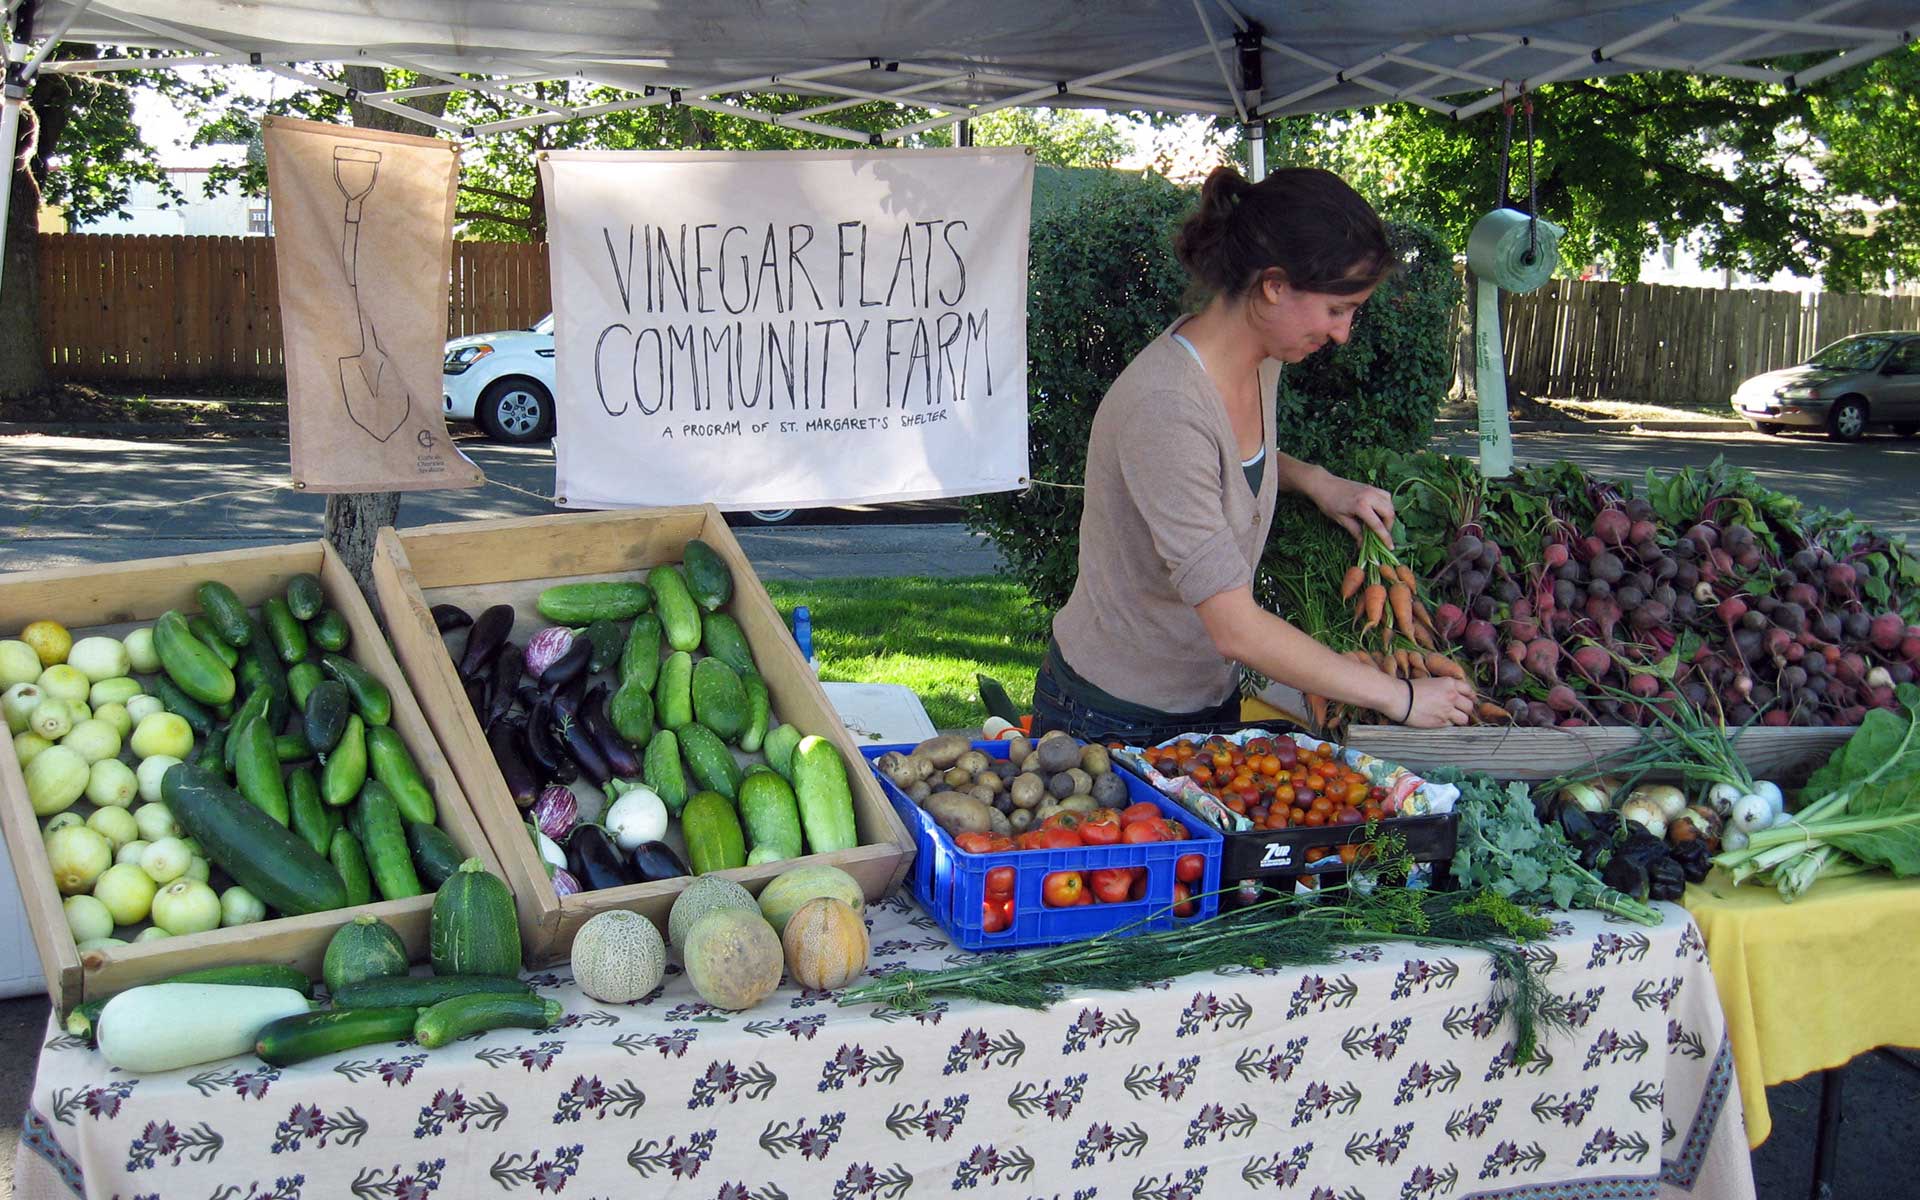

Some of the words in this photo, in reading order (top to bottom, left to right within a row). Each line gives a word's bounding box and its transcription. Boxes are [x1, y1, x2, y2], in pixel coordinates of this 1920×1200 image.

[603, 223, 823, 314] VINEGAR
[838, 220, 968, 308] FLATS
[595, 319, 869, 416] COMMUNITY
[886, 308, 992, 409] FARM
[662, 426, 674, 439] A
[683, 420, 742, 437] PROGRAM
[752, 422, 769, 433] OF
[780, 422, 798, 432] ST.
[806, 417, 888, 432] MARGARET'S
[901, 409, 947, 427] SHELTER
[1263, 843, 1290, 857] 7UP
